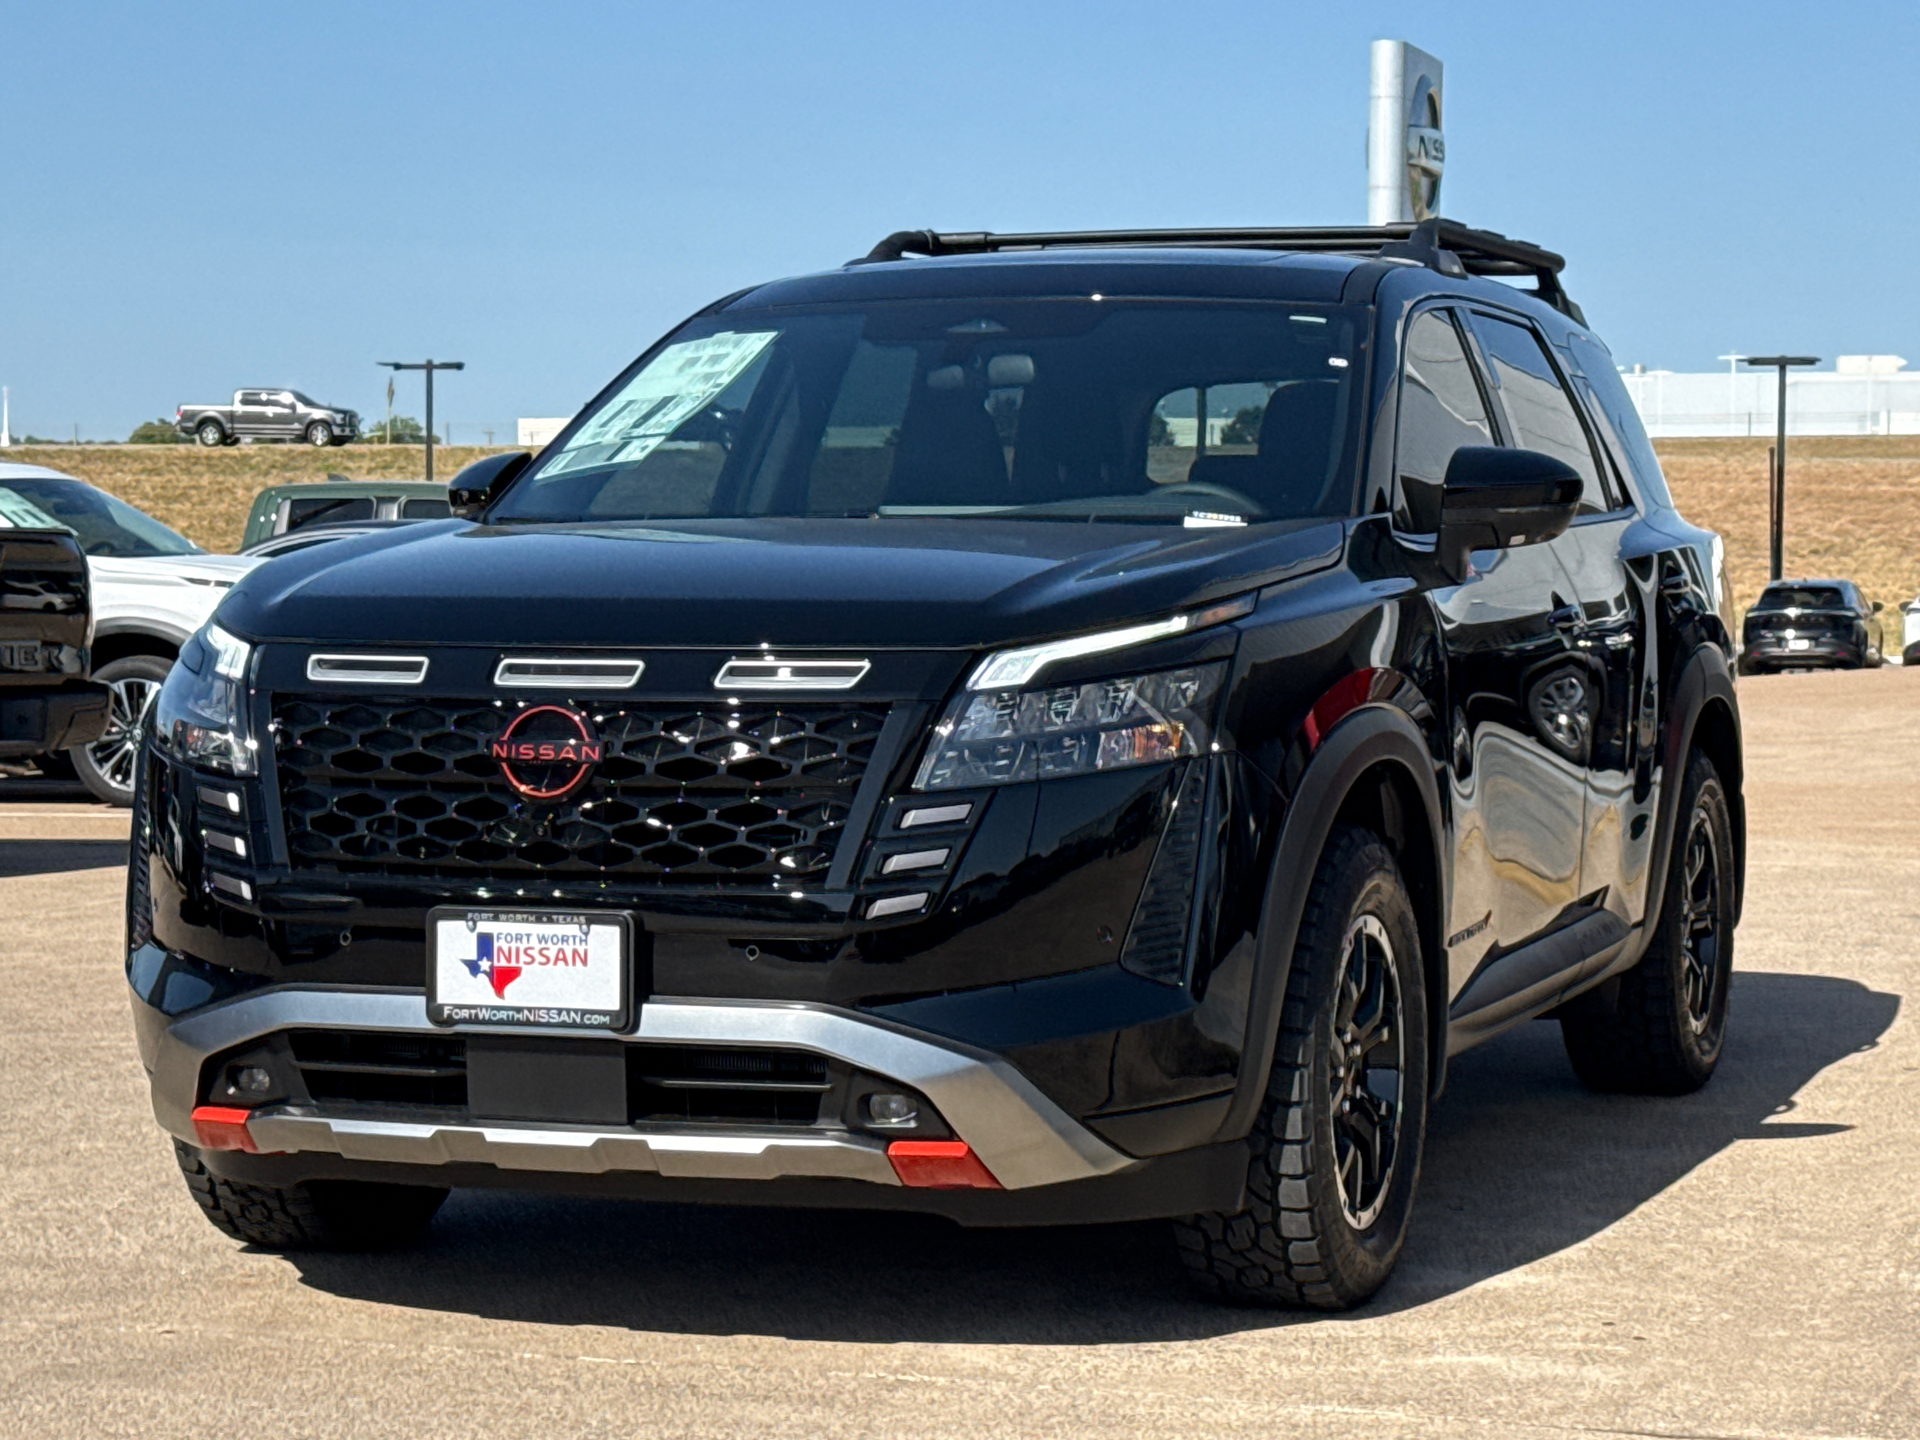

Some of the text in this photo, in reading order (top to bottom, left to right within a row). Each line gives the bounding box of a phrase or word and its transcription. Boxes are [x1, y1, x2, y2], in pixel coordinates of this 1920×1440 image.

[492, 743, 600, 761] NISSAN
[467, 912, 586, 924] FORT WORTH TEXAS
[496, 932, 588, 946] FORT WORTH
[496, 945, 588, 967] NISSAN
